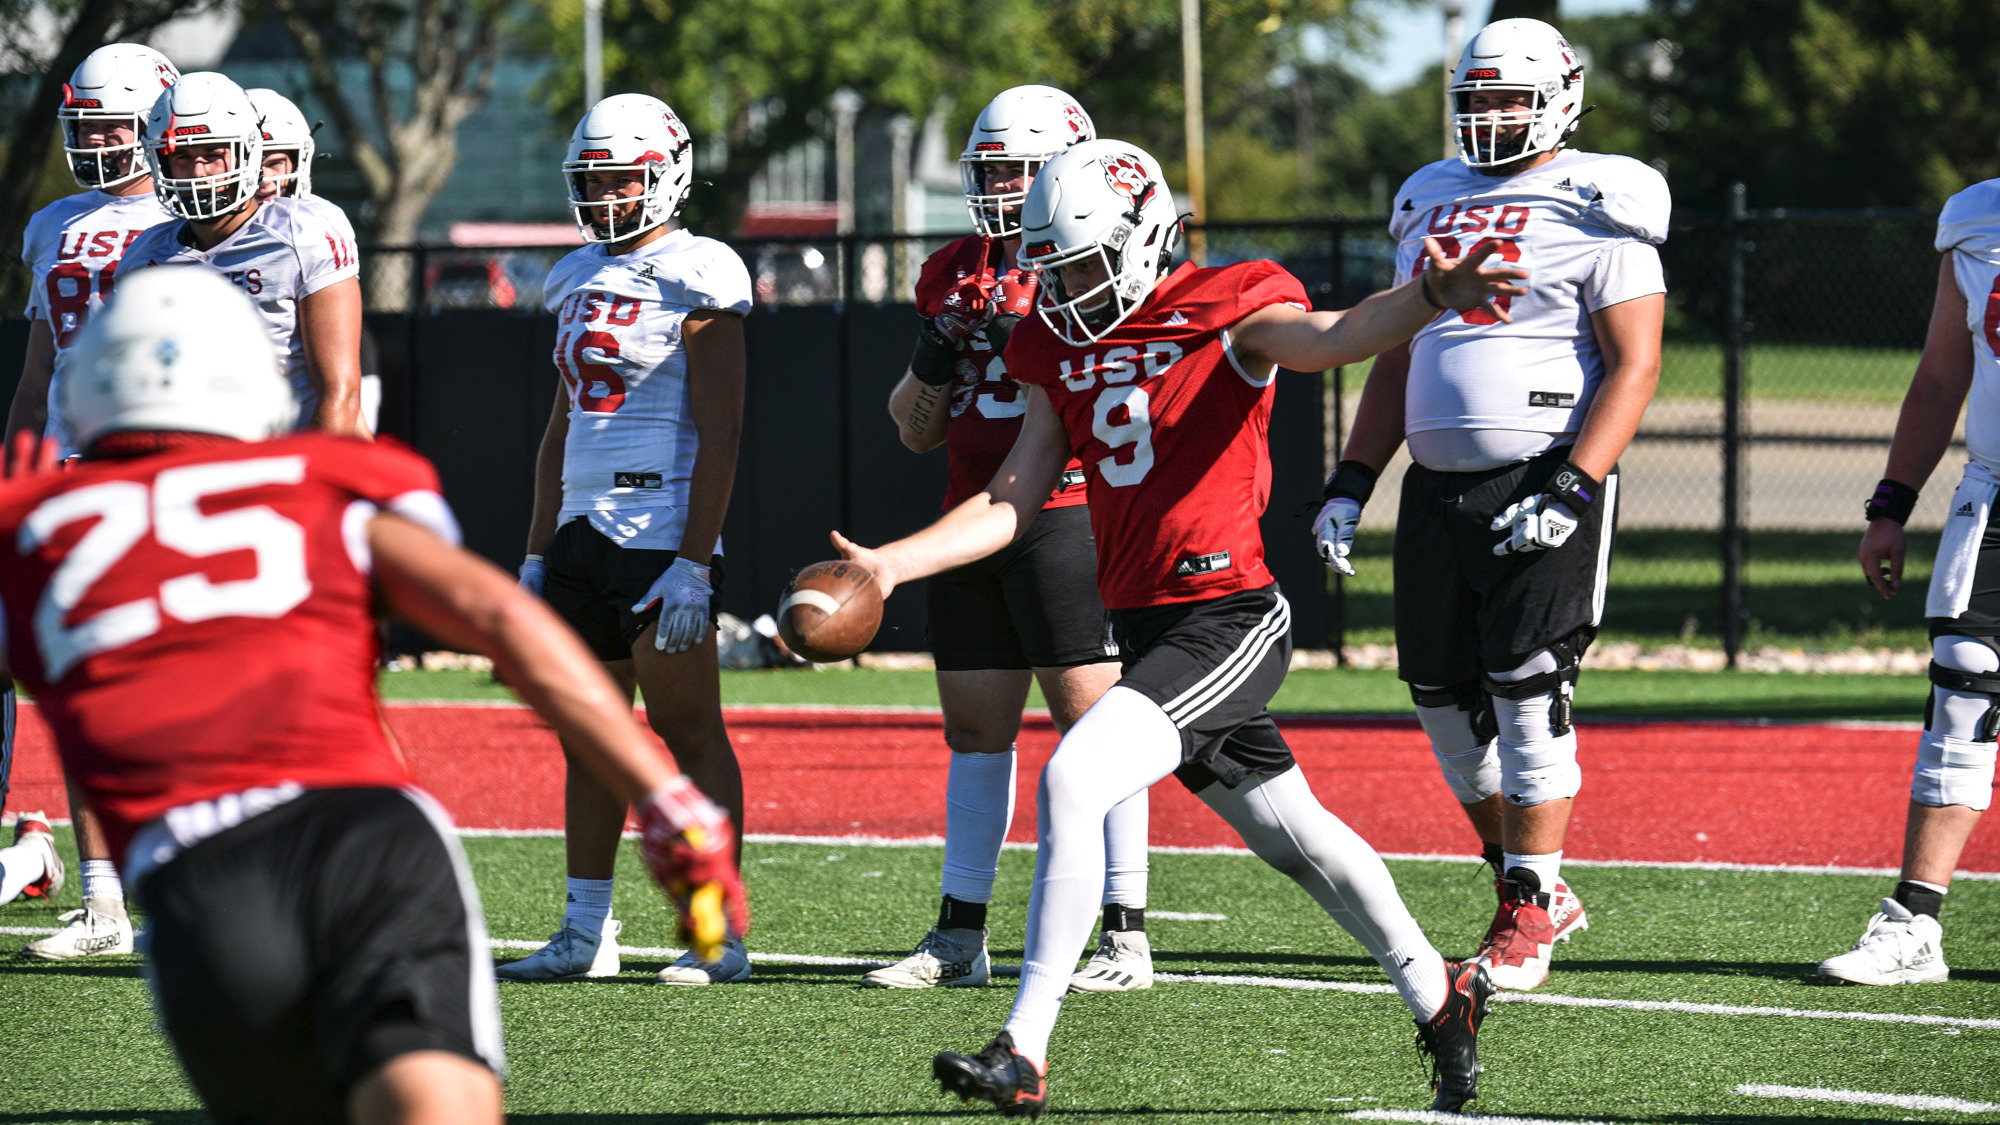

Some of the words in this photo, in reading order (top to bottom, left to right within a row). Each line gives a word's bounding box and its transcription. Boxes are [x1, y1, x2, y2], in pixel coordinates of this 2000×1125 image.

[176, 125, 208, 136] YOTES
[1427, 204, 1531, 236] USD
[46, 260, 120, 350] 8
[561, 291, 642, 327] USD
[555, 330, 627, 413] 16
[1058, 340, 1184, 393] USD
[1092, 384, 1155, 488] 9
[17, 454, 313, 684] 25
